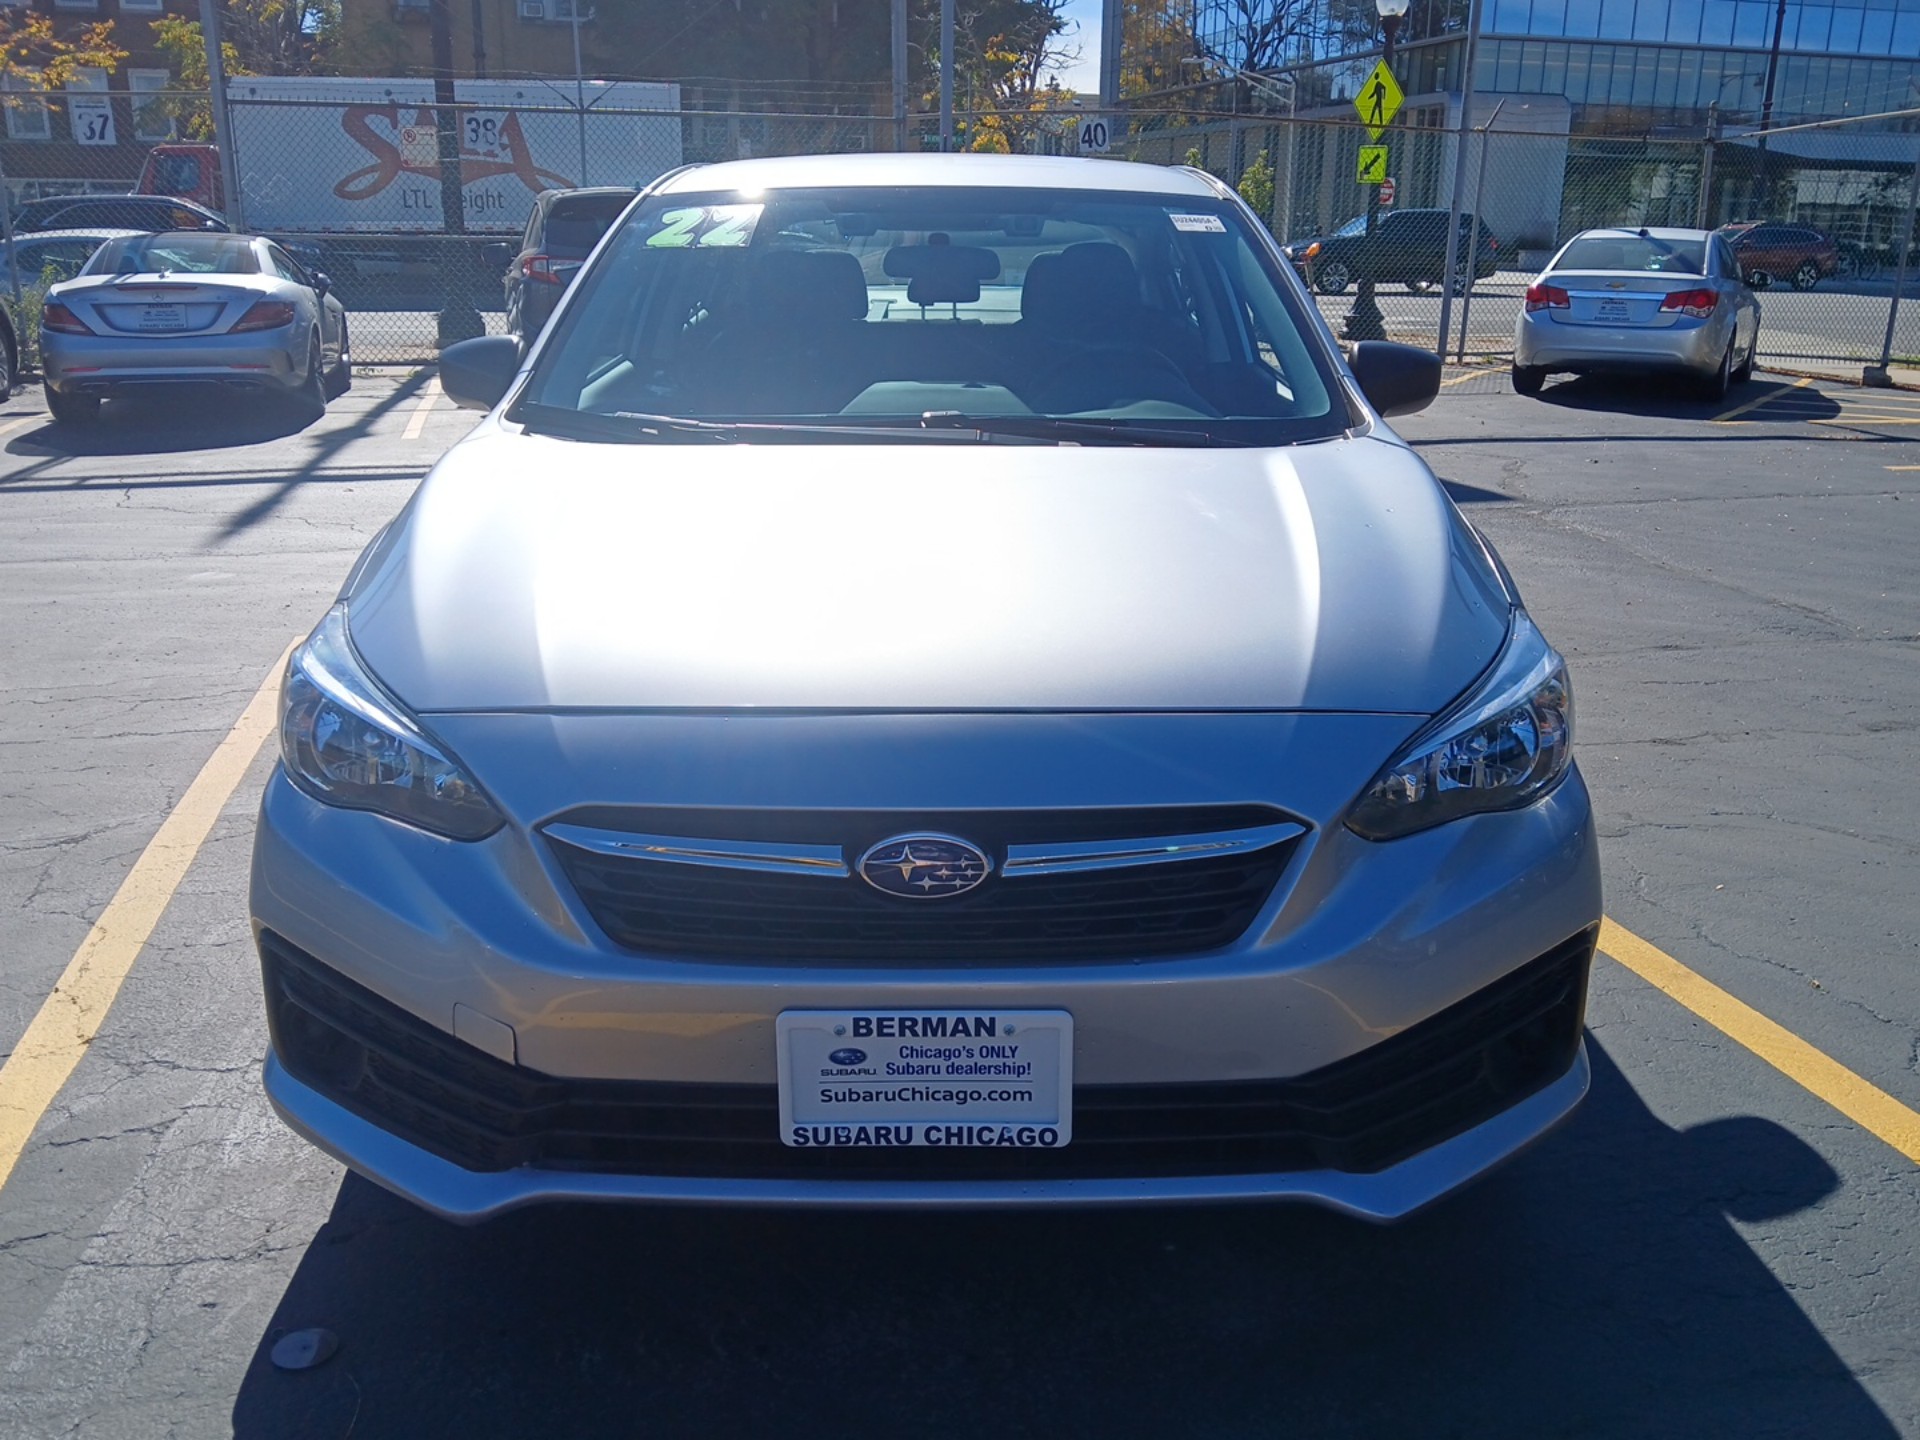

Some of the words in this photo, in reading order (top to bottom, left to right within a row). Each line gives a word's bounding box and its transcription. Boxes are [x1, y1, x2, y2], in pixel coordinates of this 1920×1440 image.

[466, 117, 497, 145] 38
[1081, 122, 1106, 148] 40
[402, 189, 433, 208] LTL
[461, 188, 505, 213] eight
[646, 207, 756, 247] 22
[852, 1016, 996, 1037] BERMAN
[899, 1045, 975, 1061] Chicago's
[979, 1045, 1018, 1058] ONLY
[820, 1068, 877, 1077] SUBARU
[886, 1062, 941, 1075] Subaru
[946, 1061, 1031, 1077] dealership!
[820, 1086, 1033, 1105] SubaruChicago.com
[793, 1126, 913, 1145] SUBARU
[924, 1125, 1059, 1146] CHICAGO
